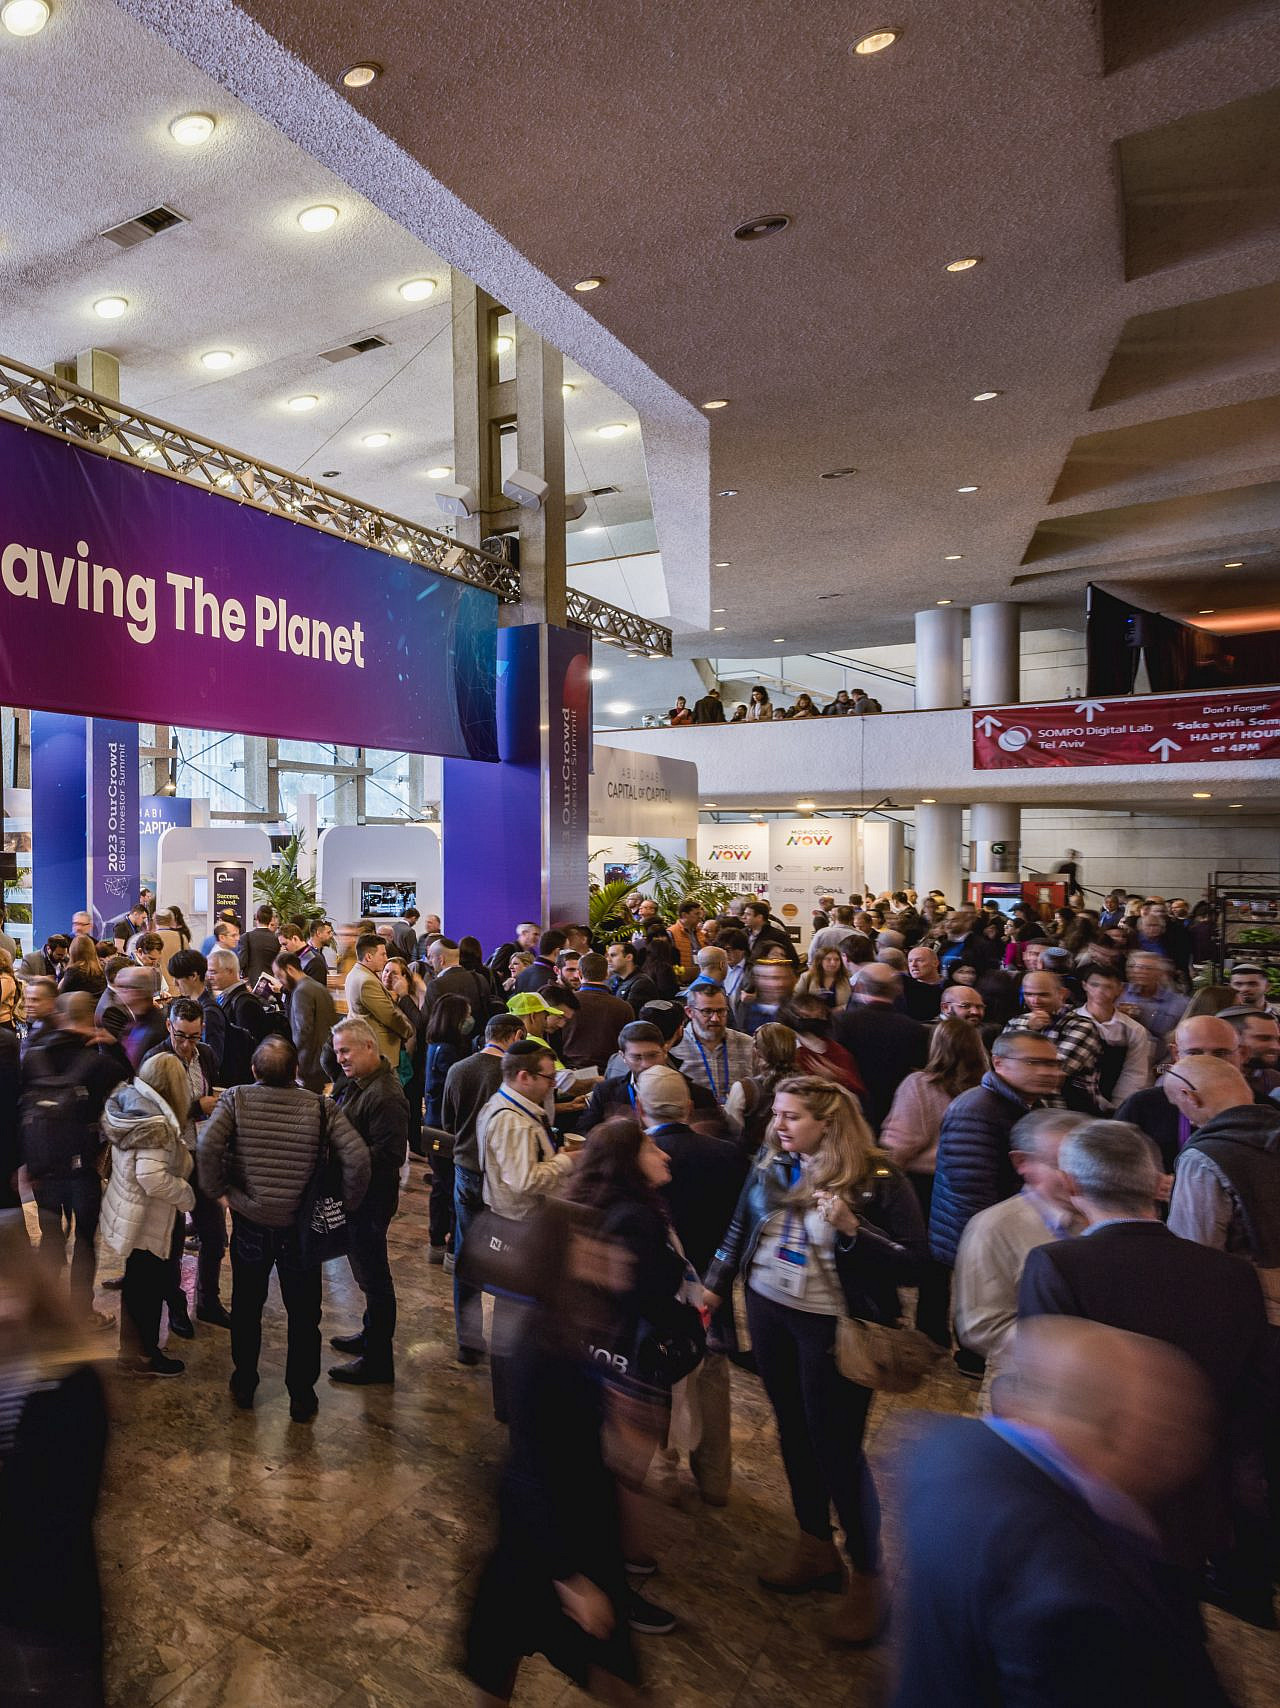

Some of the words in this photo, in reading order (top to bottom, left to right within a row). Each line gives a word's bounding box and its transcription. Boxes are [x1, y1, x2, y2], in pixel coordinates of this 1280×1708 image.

[165, 572, 247, 643] The
[254, 594, 366, 669] Planet
[1213, 719, 1245, 728] with
[1038, 727, 1084, 738] SOMPO
[1086, 725, 1127, 738] Digital
[1129, 724, 1154, 733] Lab
[1190, 732, 1237, 741] HAPPY
[1038, 740, 1056, 749] Tel
[1058, 739, 1085, 749] Aviv
[1228, 743, 1260, 752] 4PM
[108, 742, 118, 831] OurCrowd
[607, 782, 637, 800] CAPITAL
[786, 836, 833, 846] NOW
[108, 834, 118, 872] 2023
[709, 851, 752, 860] NOW
